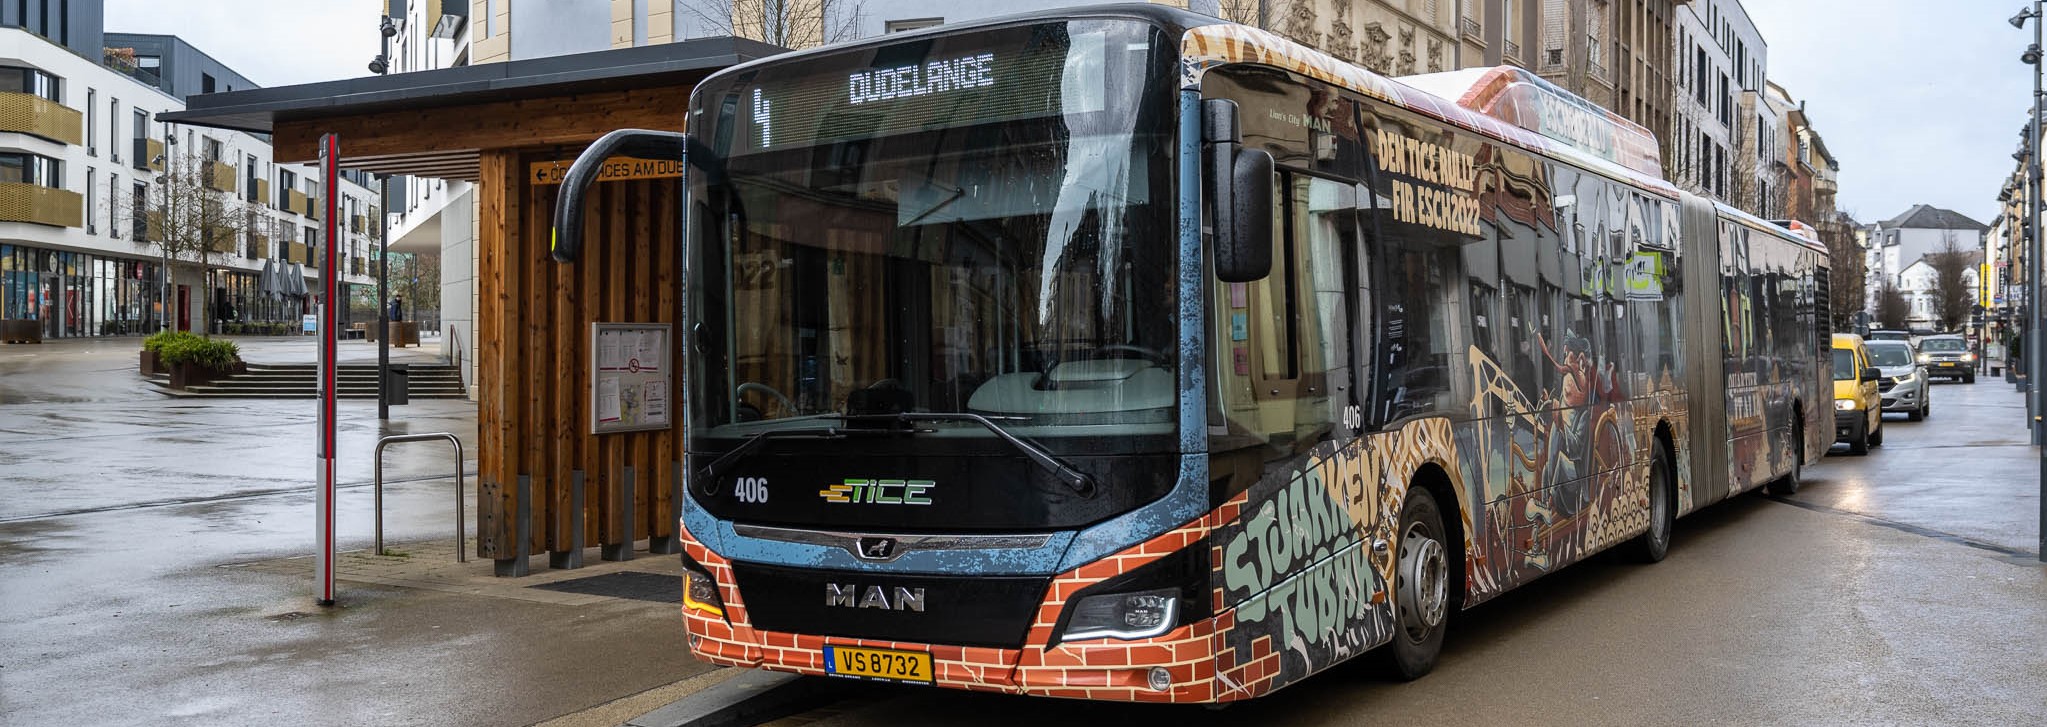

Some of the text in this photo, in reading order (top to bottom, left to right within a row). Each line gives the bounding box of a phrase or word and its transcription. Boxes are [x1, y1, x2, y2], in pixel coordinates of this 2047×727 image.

[850, 53, 994, 105] DUDELANGE
[754, 88, 770, 148] 4
[1288, 113, 1300, 127] City
[1303, 113, 1331, 134] MAN
[633, 162, 654, 177] AM
[1377, 128, 1406, 174] DEN
[1407, 138, 1438, 184] TICE
[1392, 179, 1481, 236] FIR ESCH2022
[1343, 405, 1361, 430] 406
[735, 477, 768, 503] 406
[825, 583, 925, 612] MAN
[842, 651, 866, 672] VS
[870, 653, 920, 677] 8732
